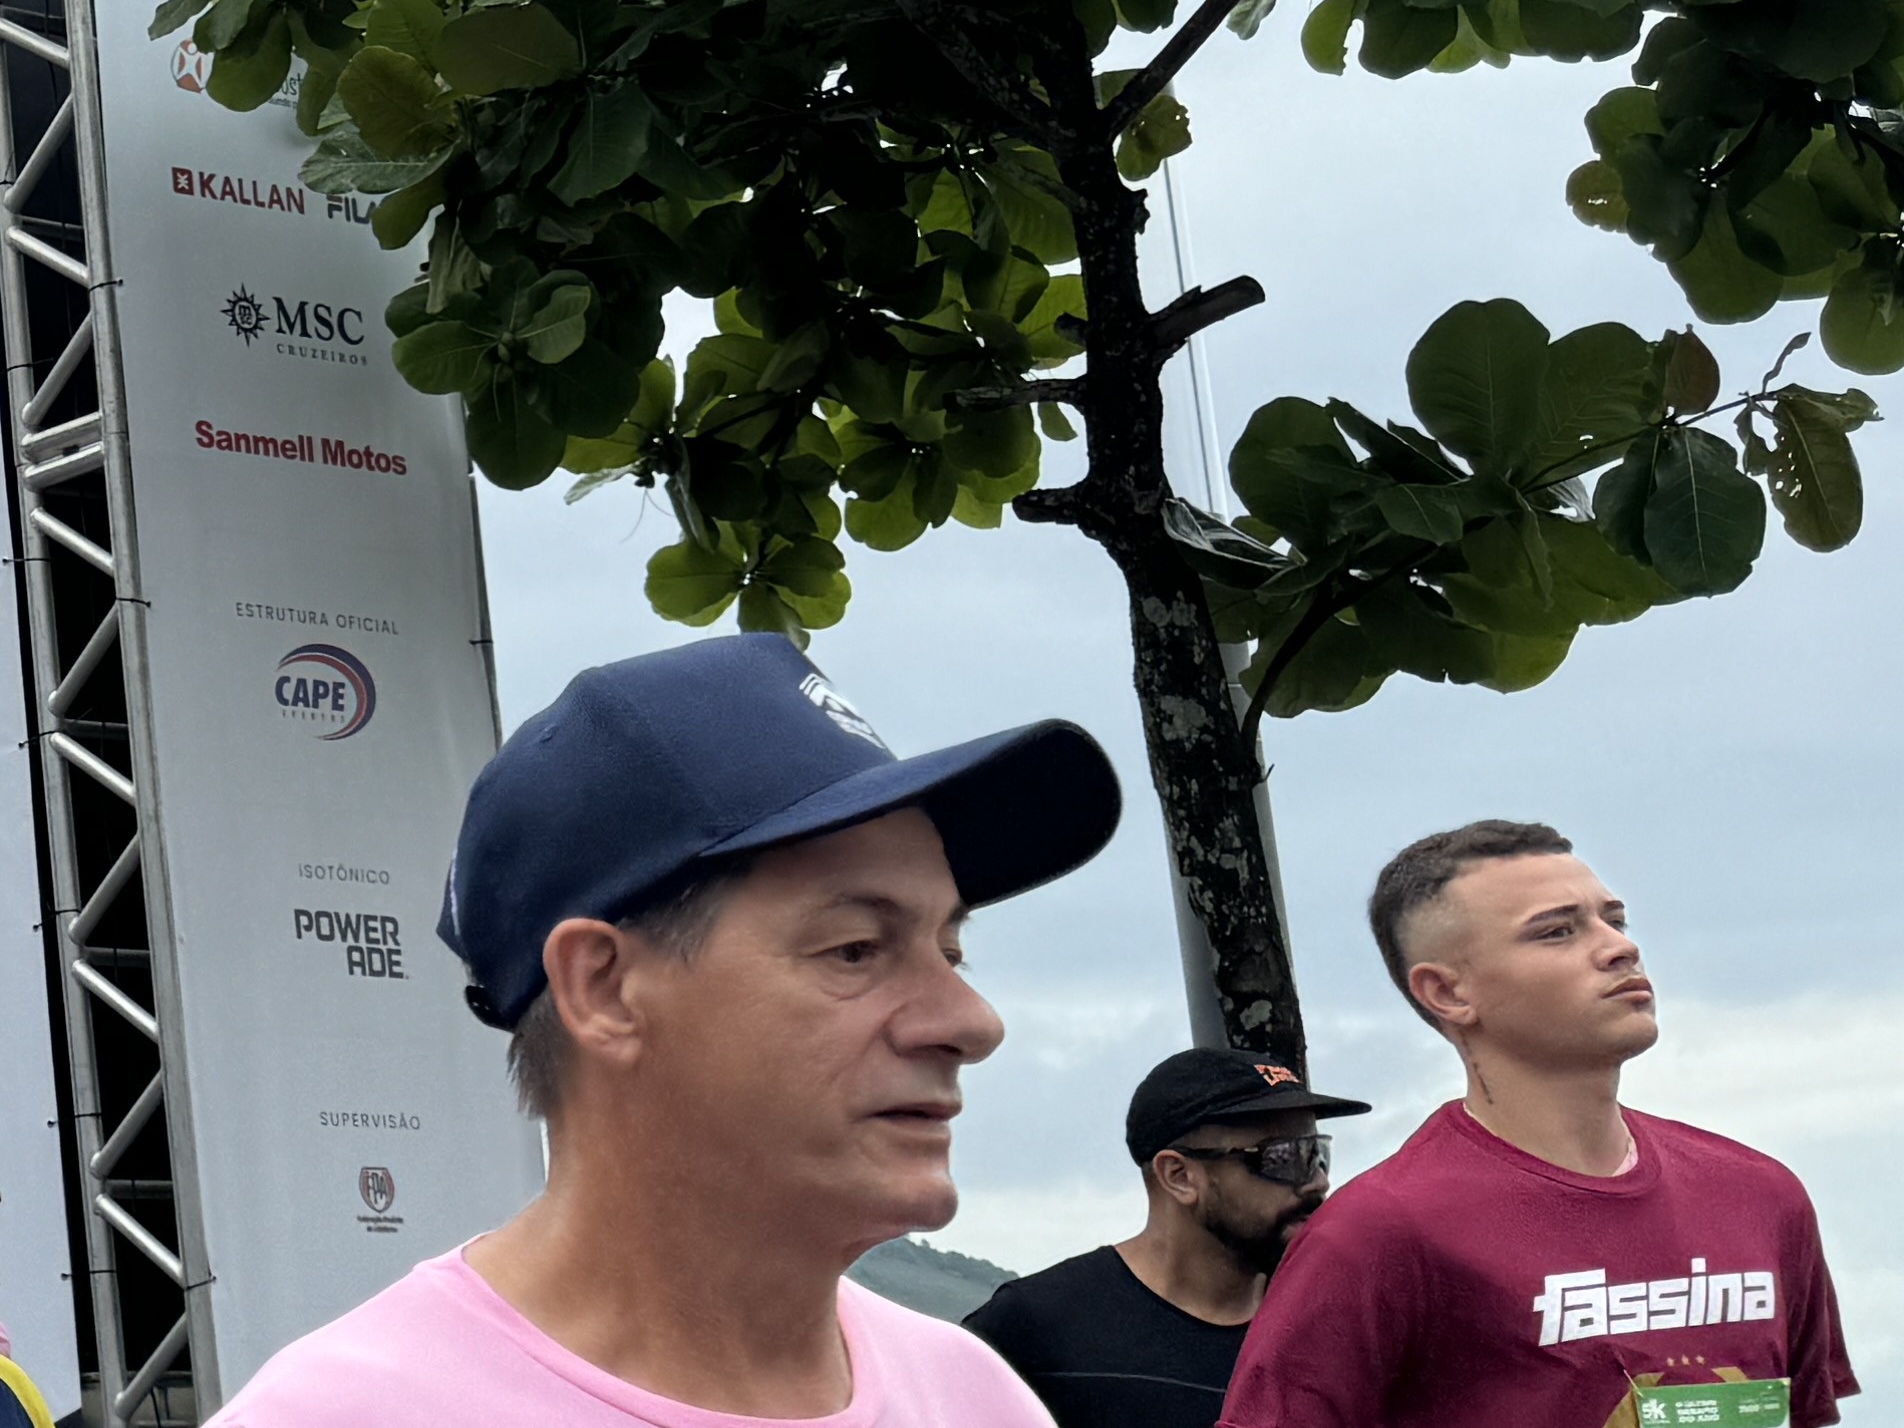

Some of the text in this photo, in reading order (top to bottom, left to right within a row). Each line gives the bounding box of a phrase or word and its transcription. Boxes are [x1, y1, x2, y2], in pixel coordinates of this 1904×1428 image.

[199, 172, 306, 215] KALLAN
[273, 297, 365, 346] MSC
[276, 343, 368, 366] CRUZEIROS
[195, 419, 408, 476] Sanmell Motos
[236, 602, 399, 635] ESTRUTURA OFICIAL
[275, 675, 346, 712] CAPE
[298, 864, 390, 885] ISOTÔNICO
[294, 908, 401, 947] POWER
[320, 1111, 421, 1130] SUPERVISÃO
[1533, 1258, 1775, 1347] fassina
